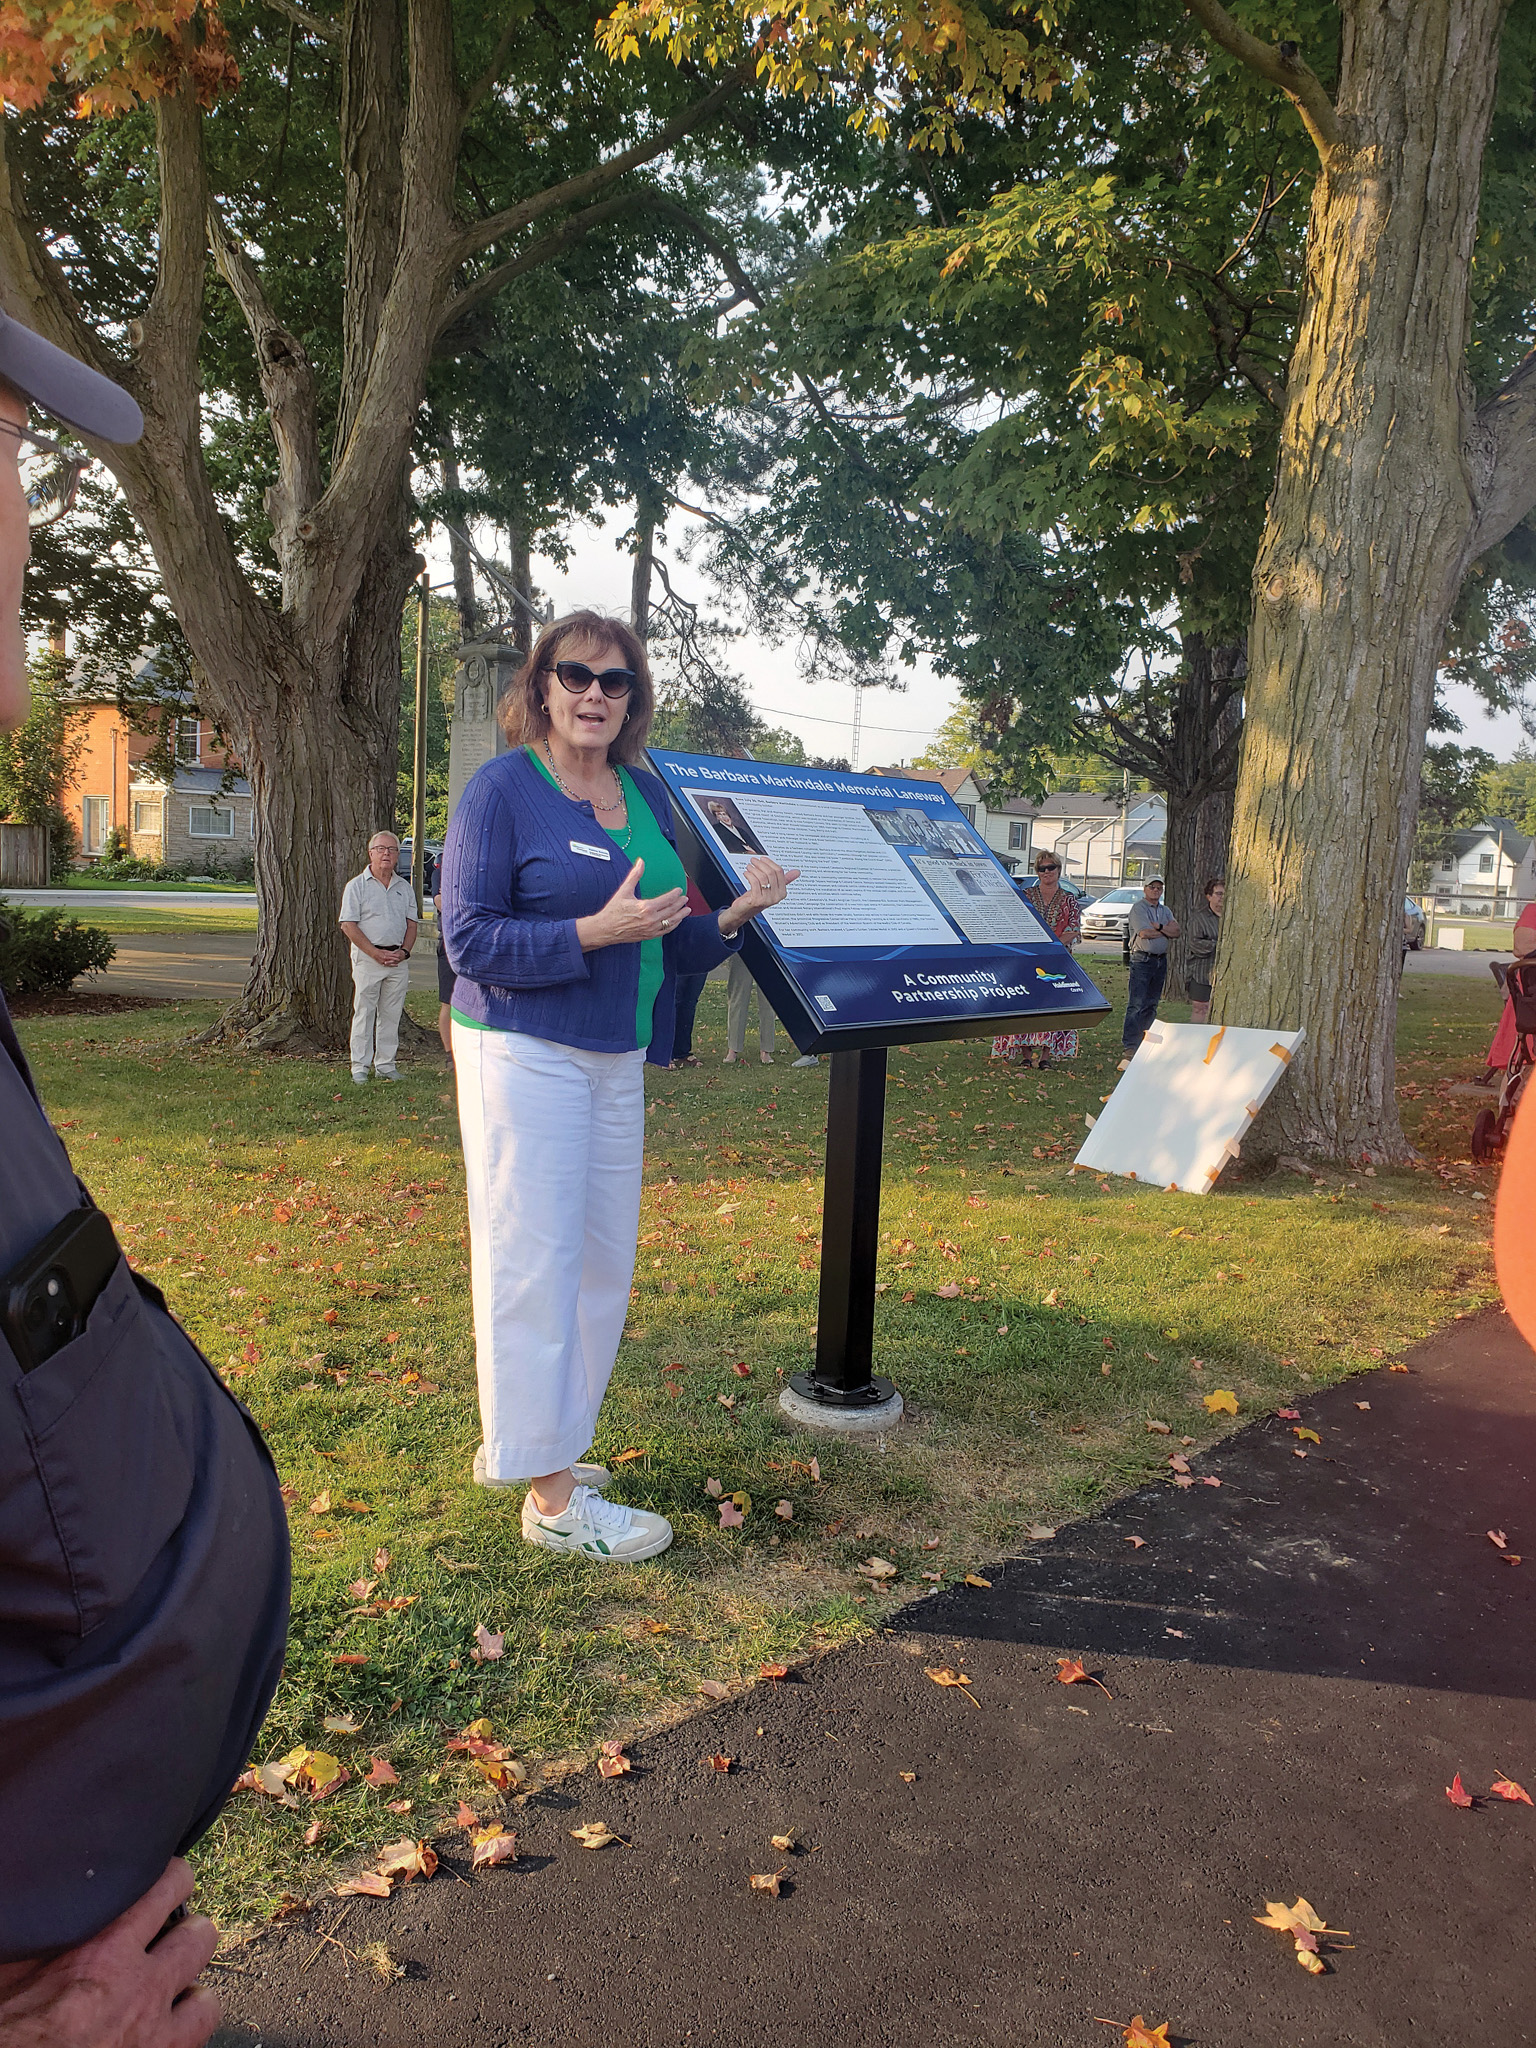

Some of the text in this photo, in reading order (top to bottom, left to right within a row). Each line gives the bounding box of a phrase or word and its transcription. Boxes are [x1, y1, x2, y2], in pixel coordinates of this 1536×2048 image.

[664, 762, 946, 805] The Barbara Martindale Memorial Laneway
[903, 970, 997, 986] A Community
[891, 983, 1030, 1003] Partnership Project
